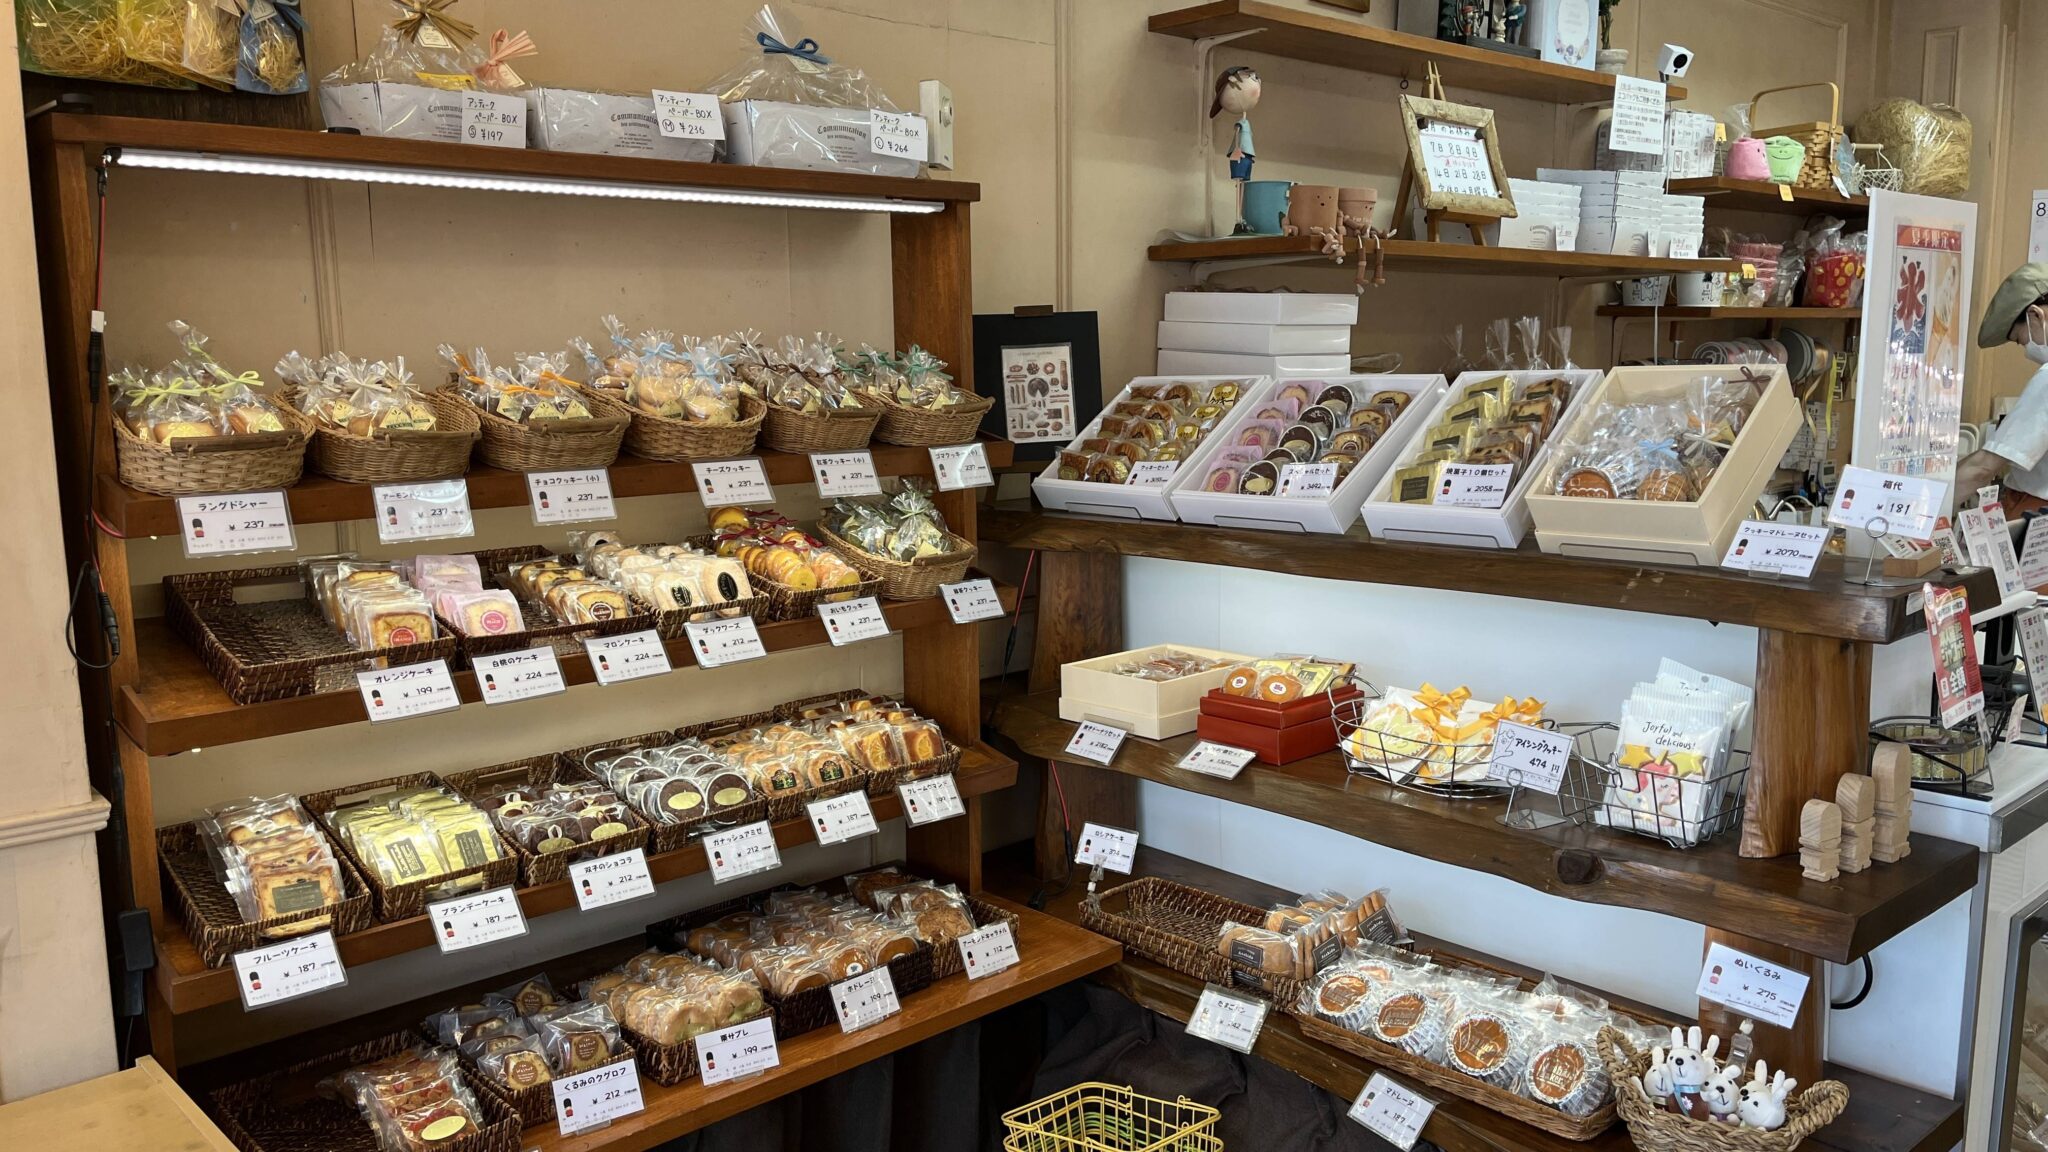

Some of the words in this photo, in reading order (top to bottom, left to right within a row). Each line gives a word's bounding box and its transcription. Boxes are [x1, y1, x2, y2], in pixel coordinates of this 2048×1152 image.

[611, 113, 659, 127] Communicatio
[817, 125, 867, 140] Communication
[1430, 141, 1443, 152] 7日
[1448, 143, 1461, 155] 8日
[706, 466, 750, 474] チーズクッキー
[850, 472, 863, 480] 237
[1288, 467, 1330, 475] スペャルセット
[738, 481, 752, 489] 237
[1474, 485, 1493, 493] 2058
[1883, 479, 1903, 491] 箱代
[578, 493, 594, 502] 237
[199, 500, 268, 512] ラングドシャー
[431, 507, 448, 517] 237
[1889, 502, 1911, 516] 181
[244, 520, 265, 530] 237
[1744, 527, 1820, 539] クッキーマドレーヌセット
[1776, 548, 1799, 557] 2070
[830, 602, 868, 614] おいもクッキー
[858, 616, 871, 625] 237
[604, 636, 645, 649] マロンケーキ
[732, 638, 745, 646] 212
[492, 653, 538, 668] 白桃のケーキ
[635, 653, 650, 661] 224
[374, 668, 433, 684] オレンジケーキ
[526, 672, 542, 681] 224
[416, 686, 433, 696] 199
[1515, 737, 1563, 755] アイシングクッキー
[1529, 757, 1547, 769] 474
[827, 800, 849, 812] ガレット
[747, 845, 759, 854] 212
[584, 855, 632, 874] 双子のショコラ
[619, 875, 632, 884] 212
[442, 896, 505, 916] ブランデーケーキ
[485, 915, 501, 925] 187
[253, 941, 318, 964] フルーツケーキ
[297, 962, 316, 973] 187
[1756, 987, 1777, 1001] 275
[743, 1046, 759, 1056] 199
[564, 1067, 627, 1091] くるみのクグロフ
[605, 1090, 621, 1101] 212
[1386, 1087, 1414, 1107] マドレーヌ
[1393, 1112, 1406, 1124] 187
